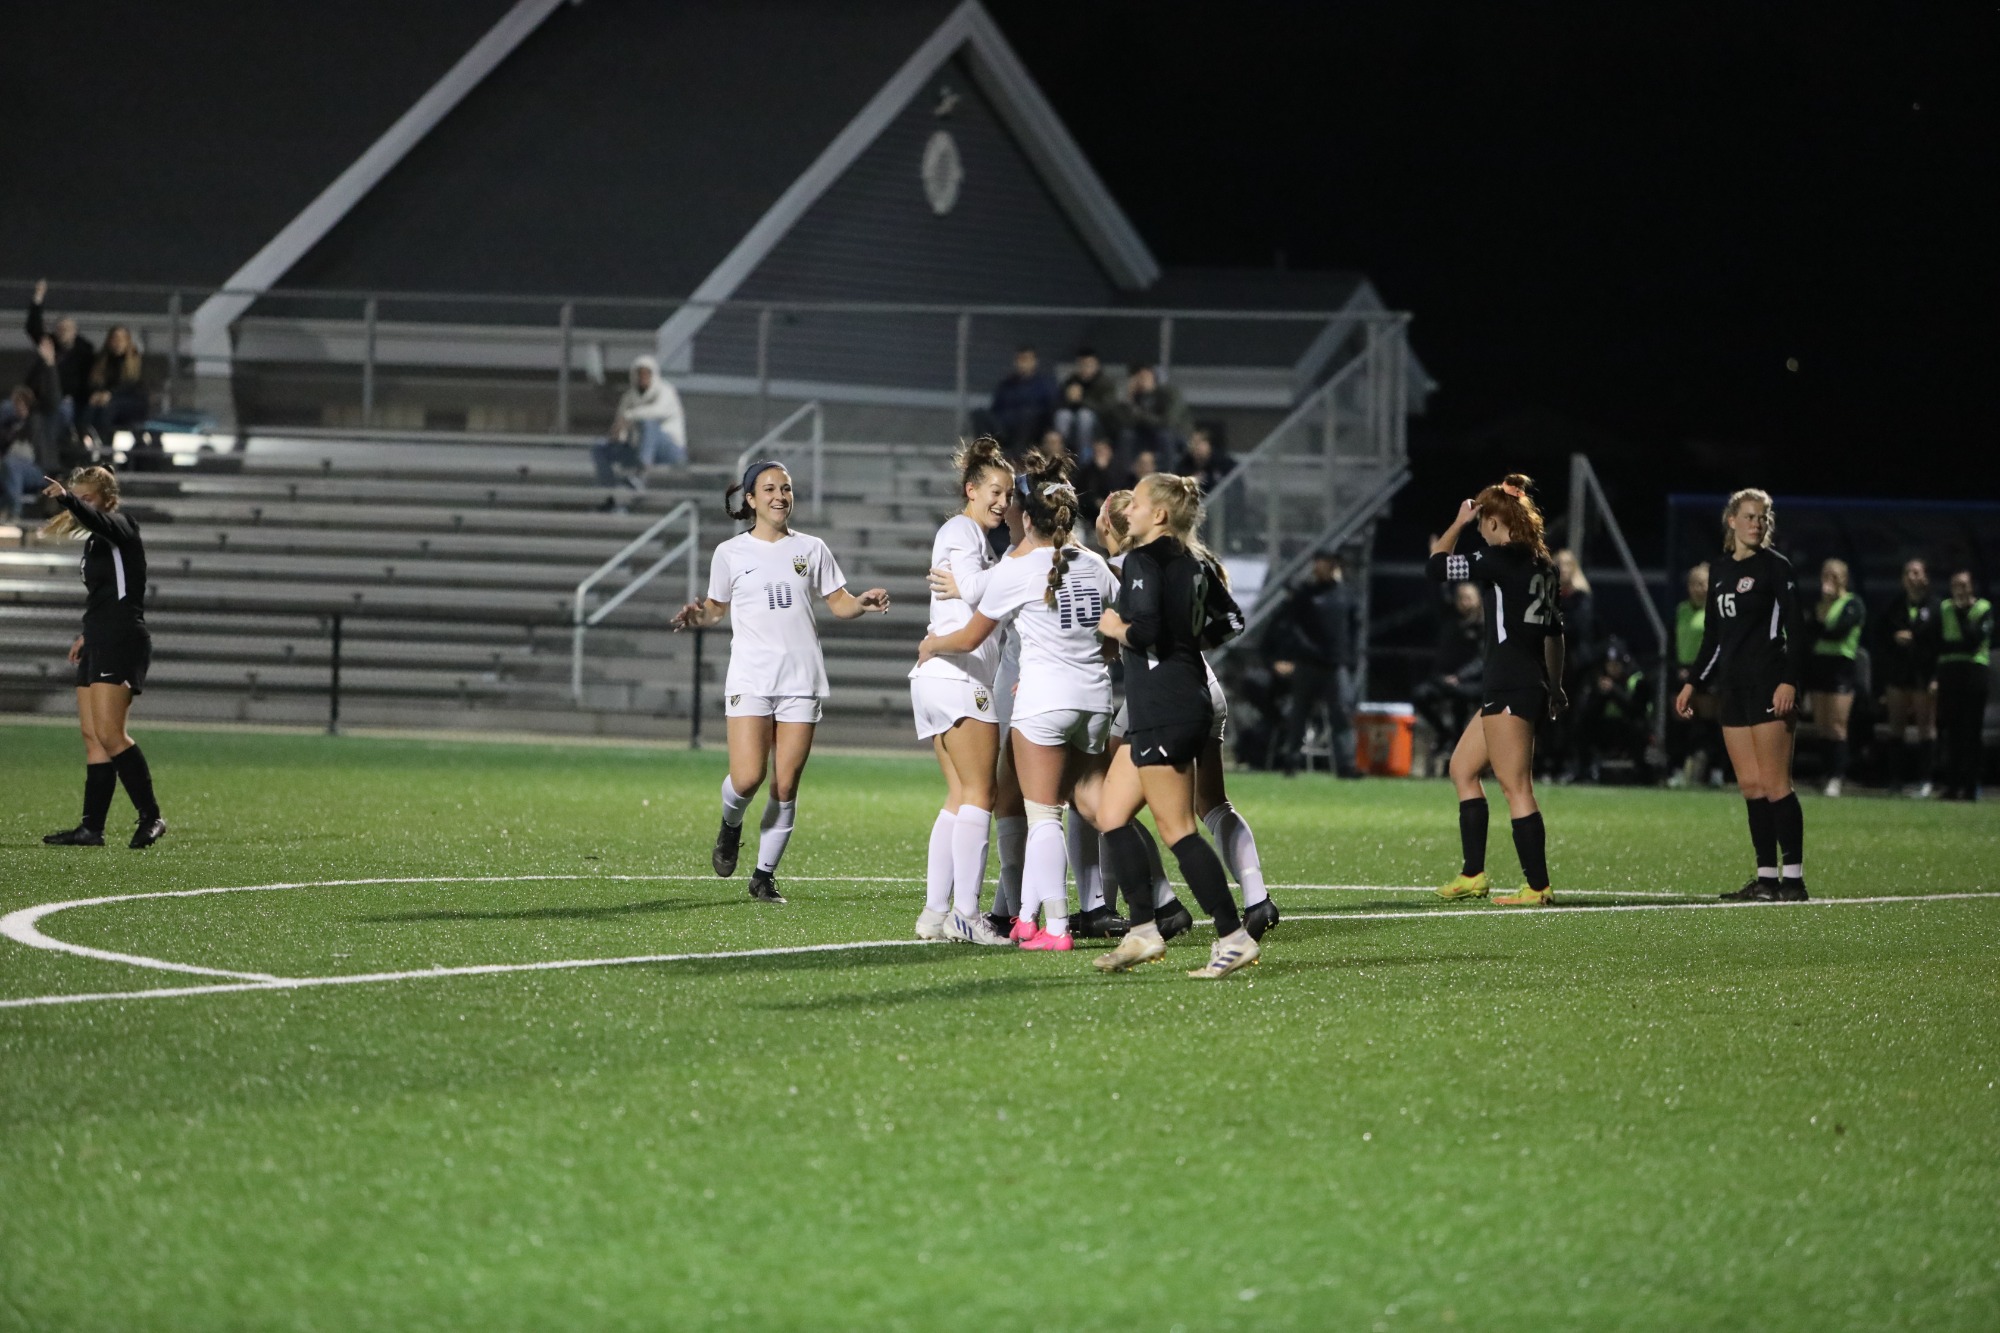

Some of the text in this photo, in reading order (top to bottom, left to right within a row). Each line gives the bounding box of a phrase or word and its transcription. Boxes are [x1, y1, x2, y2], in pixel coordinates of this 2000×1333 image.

[763, 581, 792, 610] 10
[1058, 569, 1101, 629] 15
[1717, 593, 1737, 618] 15
